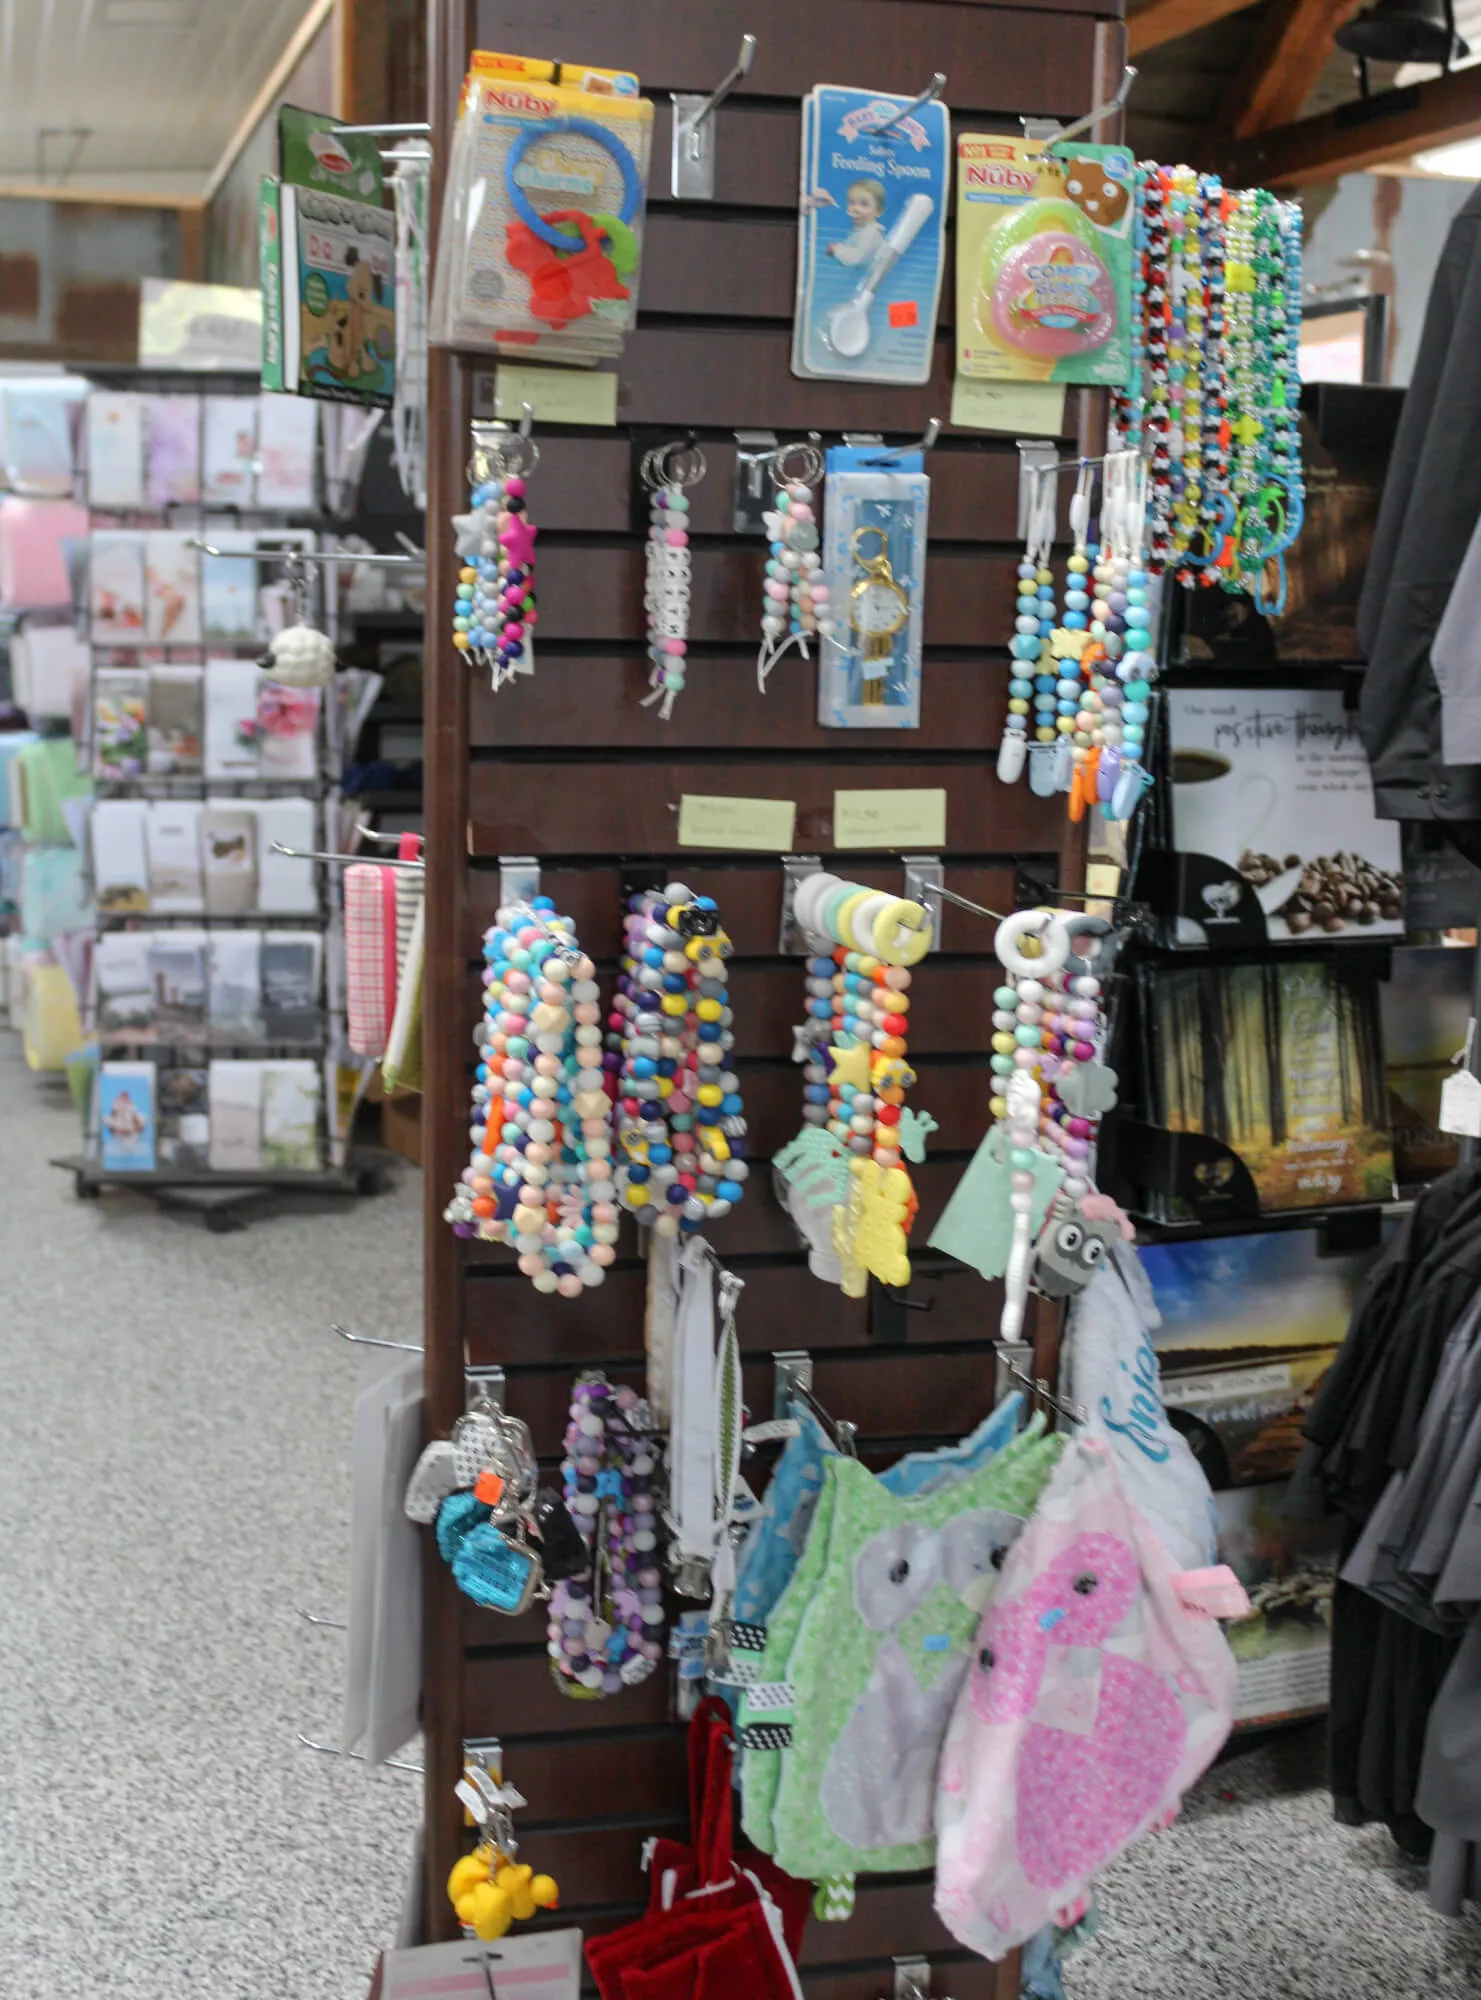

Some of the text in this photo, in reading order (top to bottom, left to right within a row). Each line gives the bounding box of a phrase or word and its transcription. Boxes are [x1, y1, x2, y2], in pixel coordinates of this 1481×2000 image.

[516, 162, 592, 194] Charms
[832, 152, 931, 180] Feeding Spoon
[1026, 264, 1098, 282] COMFY
